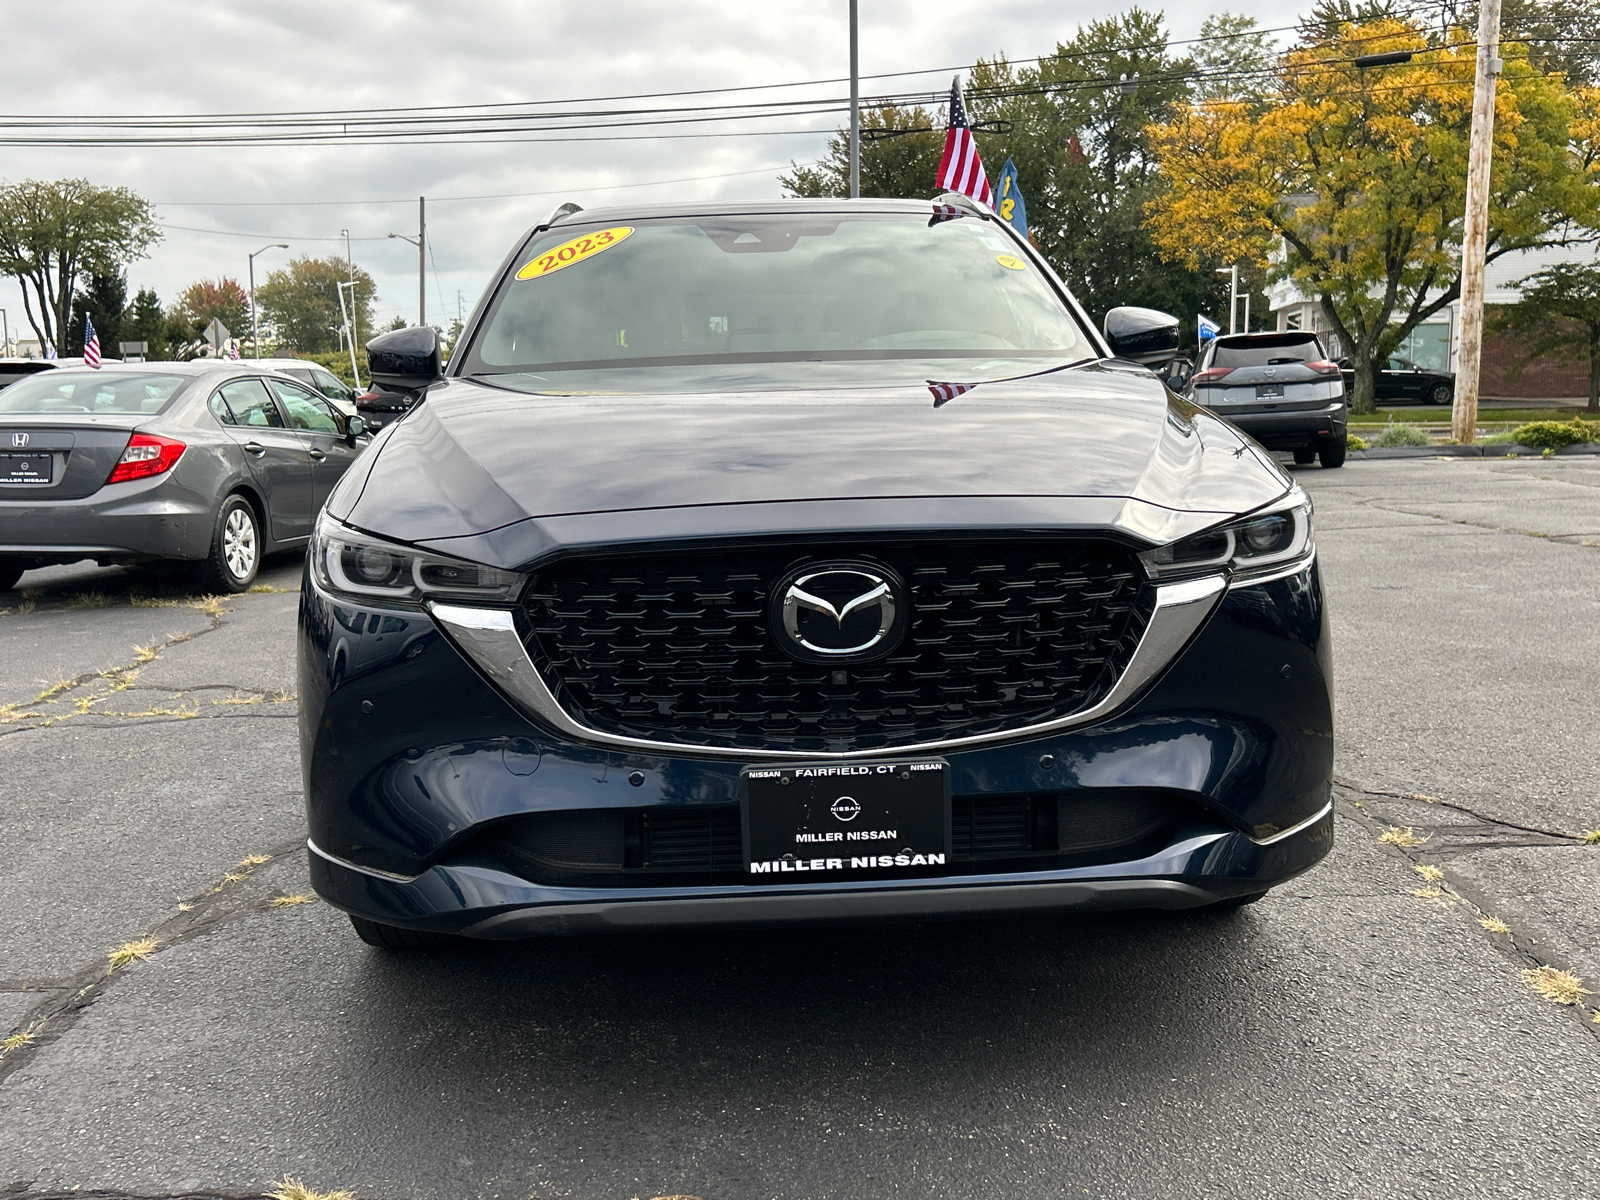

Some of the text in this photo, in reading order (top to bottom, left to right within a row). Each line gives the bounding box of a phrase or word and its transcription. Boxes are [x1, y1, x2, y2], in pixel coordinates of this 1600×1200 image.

[539, 231, 614, 272] 2023
[795, 767, 873, 778] FAIRFIELD,
[876, 765, 896, 774] CT
[796, 830, 897, 843] MILLER NISSAN
[750, 853, 945, 873] MILLER NISSAN
